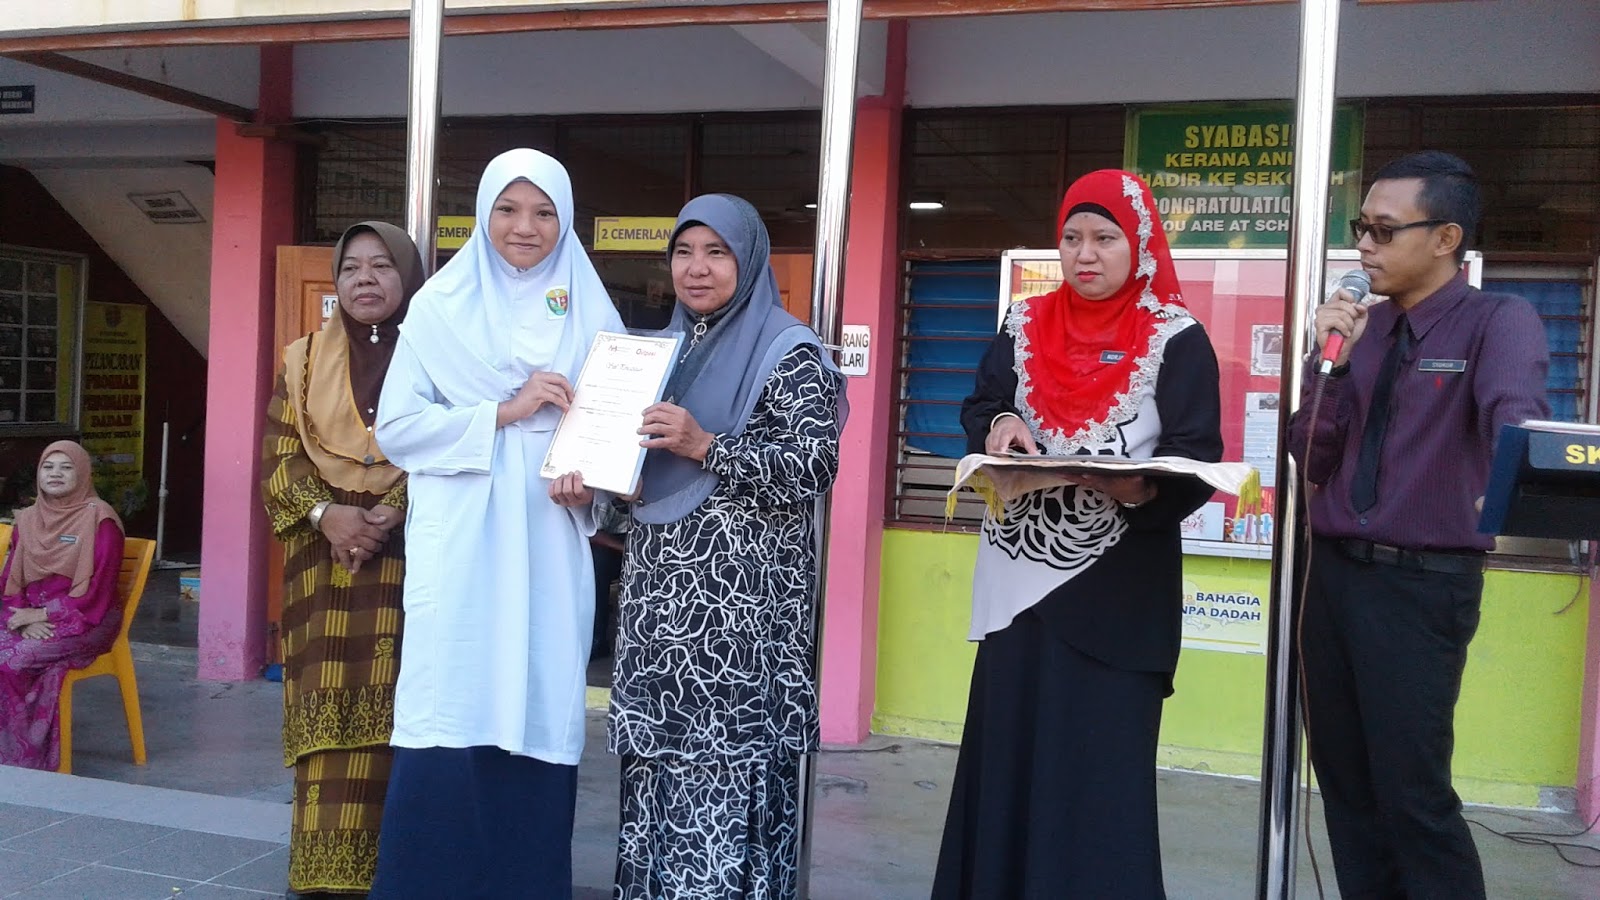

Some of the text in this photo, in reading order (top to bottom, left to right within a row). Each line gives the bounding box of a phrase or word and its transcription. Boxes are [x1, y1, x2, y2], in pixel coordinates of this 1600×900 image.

[1165, 151, 1293, 168] KERANA AN
[1139, 171, 1344, 188] HADIR KE SEKH
[437, 226, 472, 238] EMERL
[1160, 219, 1289, 232] OU ARE AT SCH
[601, 228, 672, 240] 2 CEMERLAN
[843, 332, 869, 348] RANG
[841, 353, 864, 367] LARI
[1565, 444, 1600, 464] SK
[1196, 592, 1261, 606] BAHAGIA
[1181, 606, 1261, 620] NPA DADAH
